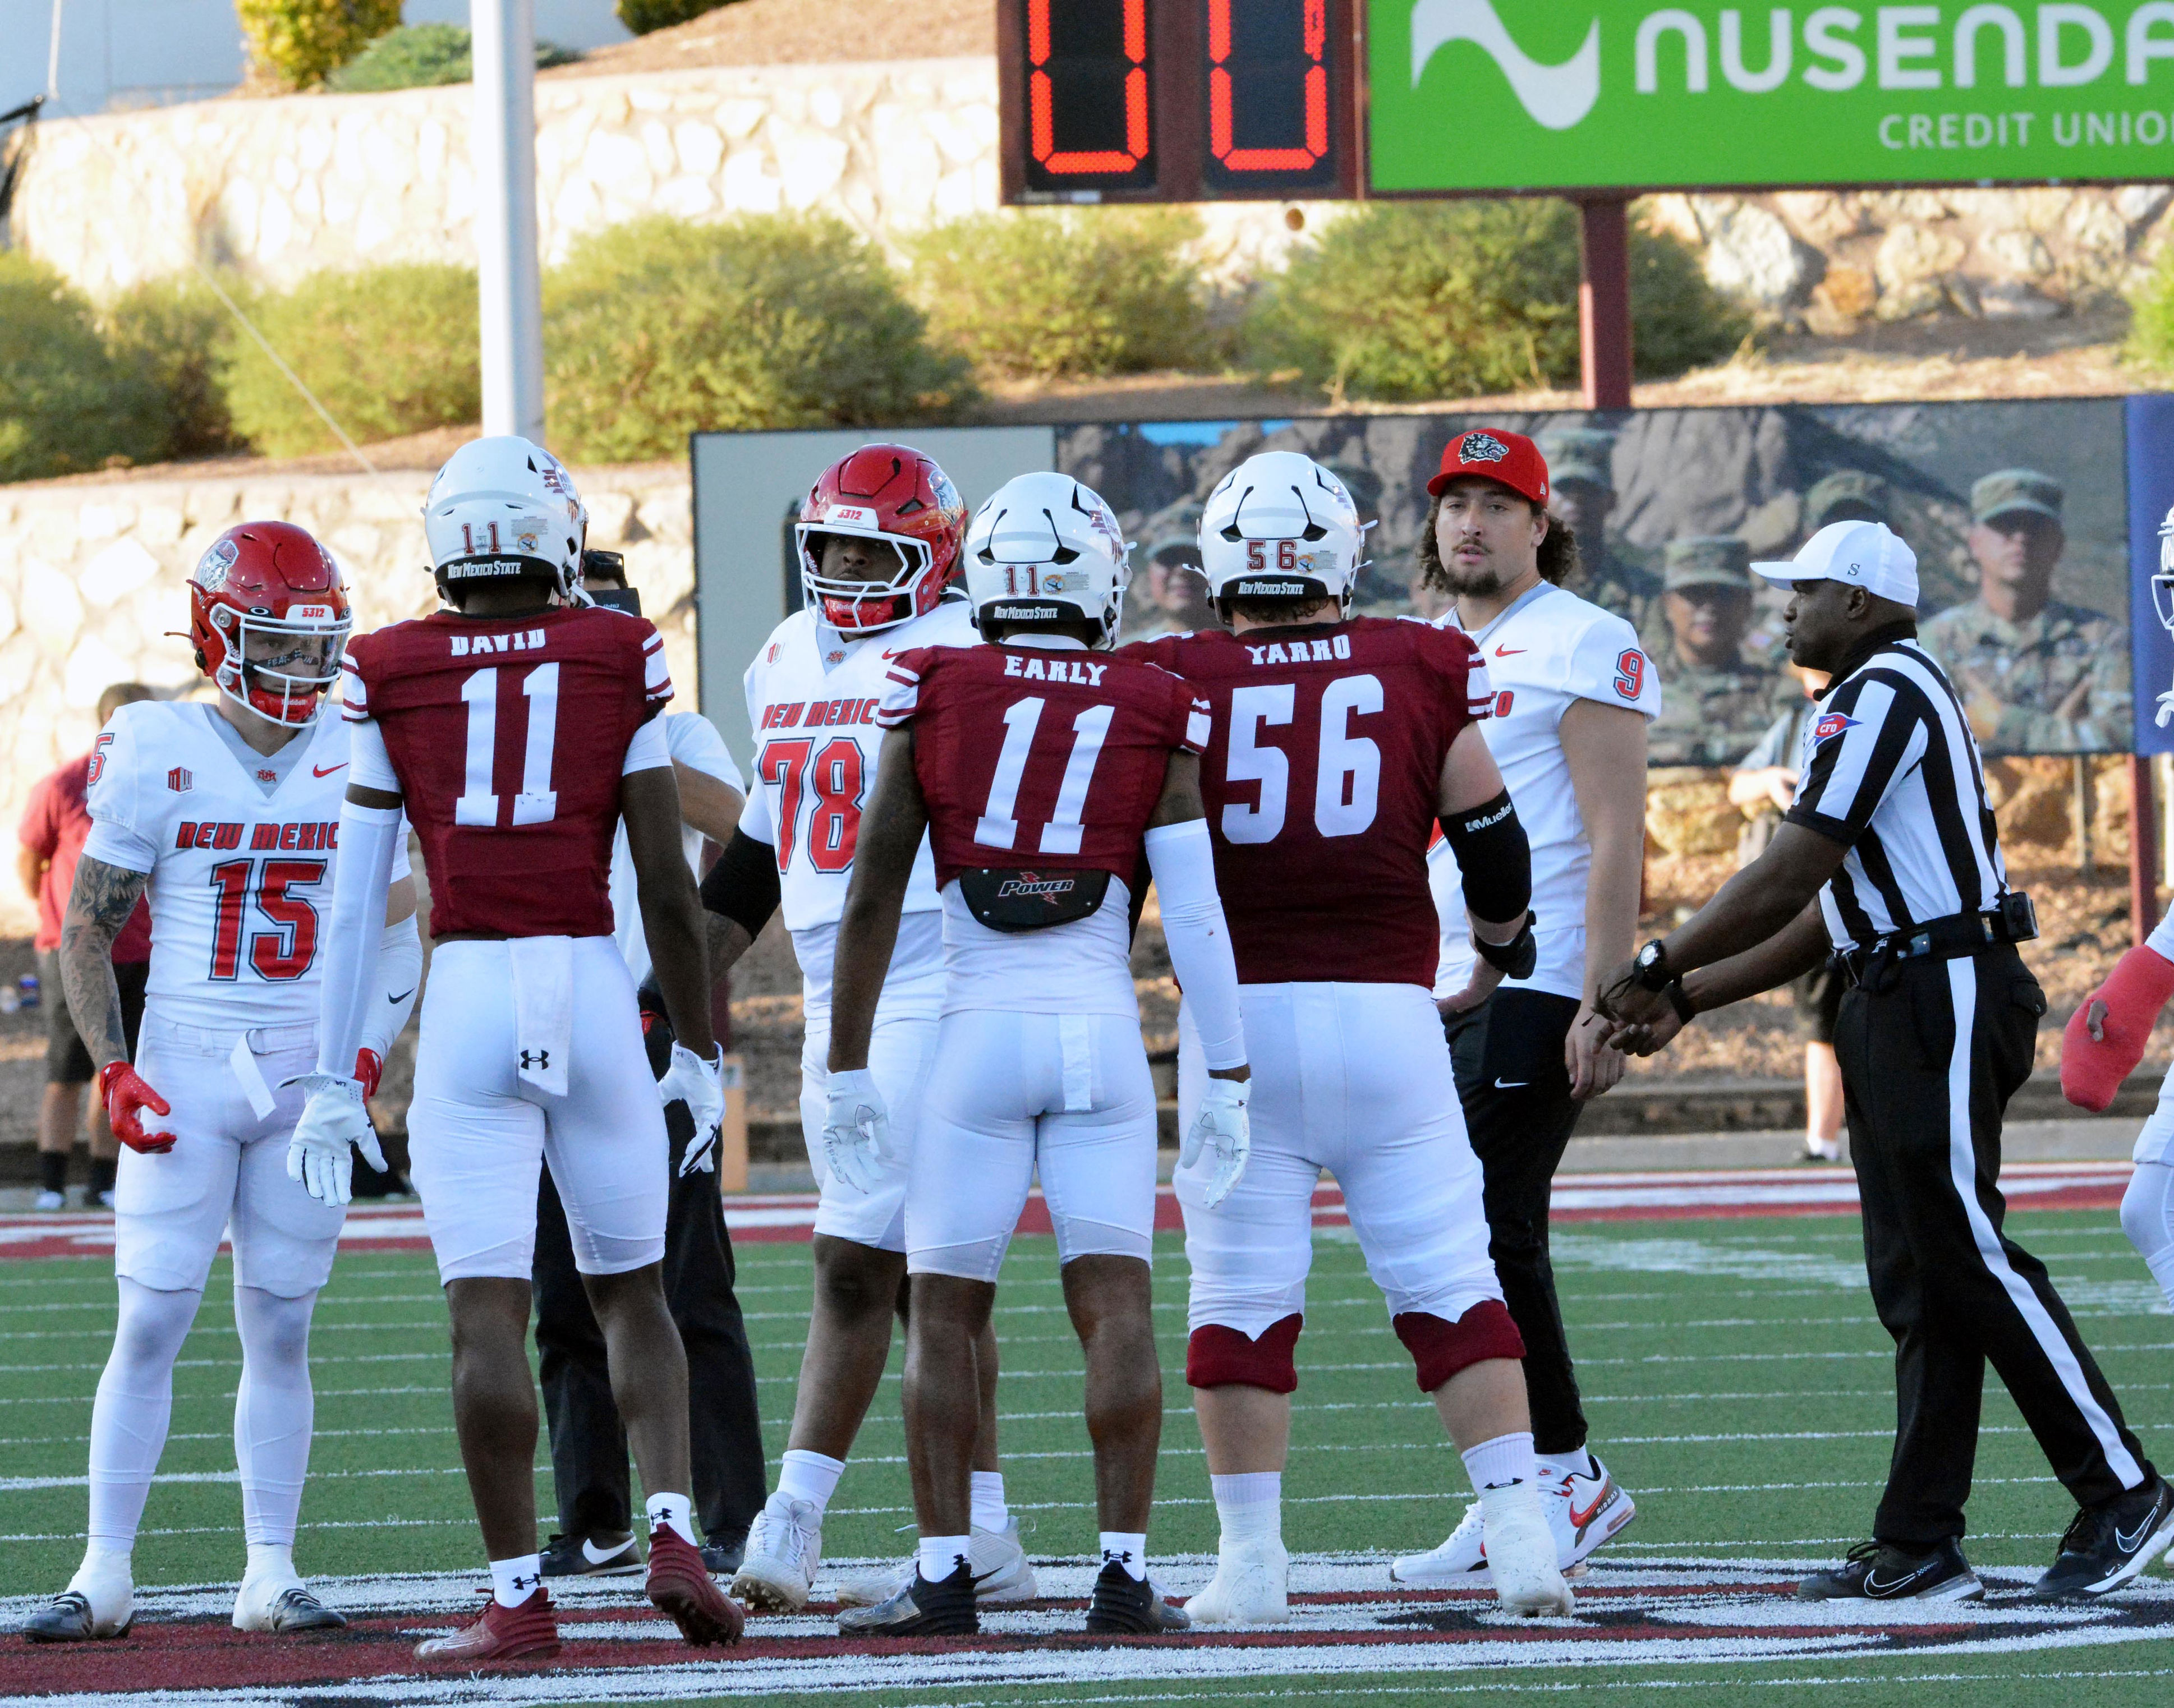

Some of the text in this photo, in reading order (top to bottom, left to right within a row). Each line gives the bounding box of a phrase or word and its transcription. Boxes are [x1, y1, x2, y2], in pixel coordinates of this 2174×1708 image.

[1878, 111, 2174, 149] CREDIT UNIO
[838, 509, 862, 520] 5312
[448, 560, 521, 579] NEW MEXICO STATE
[1847, 563, 1860, 576] S
[302, 607, 325, 618] 5312
[449, 628, 546, 657] DAVID
[1245, 634, 1351, 665] YARRO
[1004, 655, 1107, 687] EARLY
[1613, 648, 1645, 702] 9
[761, 698, 880, 730] NEW MEXIC
[1820, 724, 1837, 733] CFO
[455, 662, 559, 827] 11
[1221, 674, 1384, 845] 56
[974, 696, 1115, 854] 11
[759, 736, 865, 875] 78
[1472, 802, 1513, 830] Mueller
[176, 822, 339, 851] NEW MEXIC
[998, 880, 1074, 897] POWER
[208, 858, 328, 983] 15
